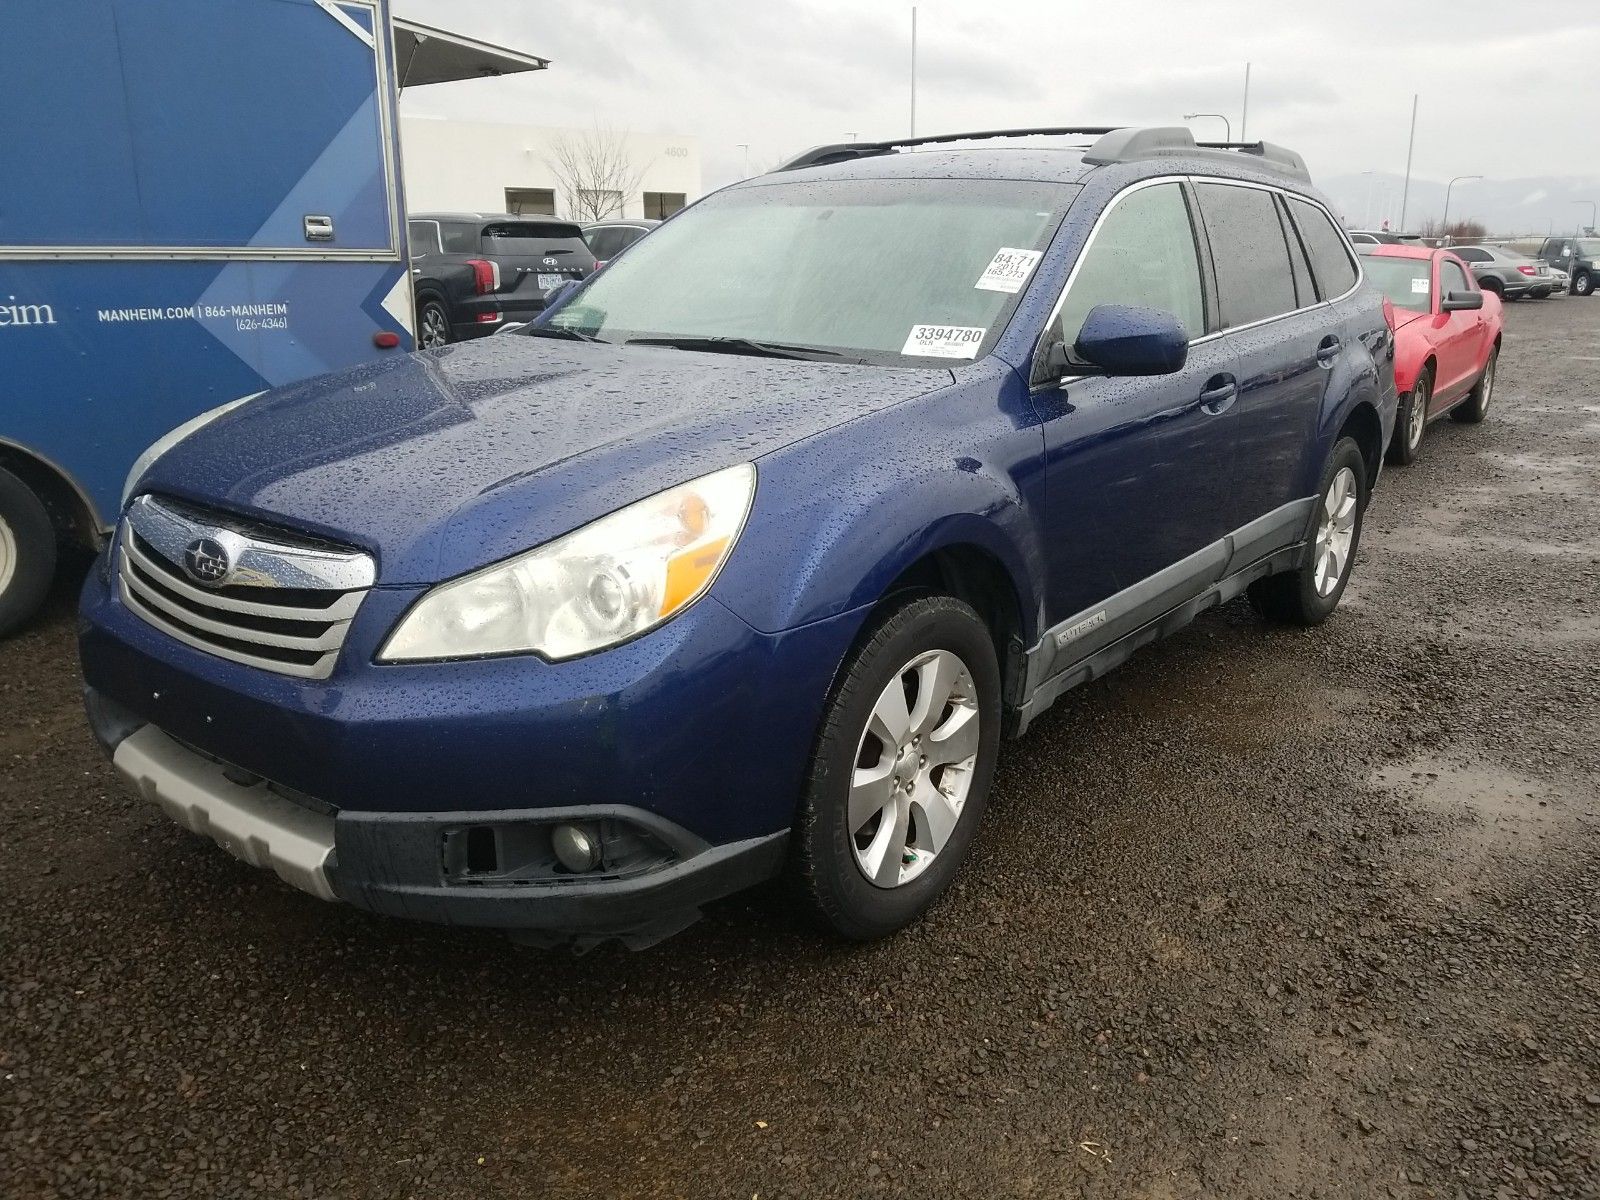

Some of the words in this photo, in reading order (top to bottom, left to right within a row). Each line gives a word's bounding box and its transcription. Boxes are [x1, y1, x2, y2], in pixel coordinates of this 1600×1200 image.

[997, 263, 1020, 271] 2011
[0, 295, 58, 326] eim
[98, 306, 195, 322] MANHEIM.COM
[204, 303, 287, 318] 866-MANHEIM
[236, 317, 288, 331] (626-4346)
[915, 327, 982, 343] 3394780
